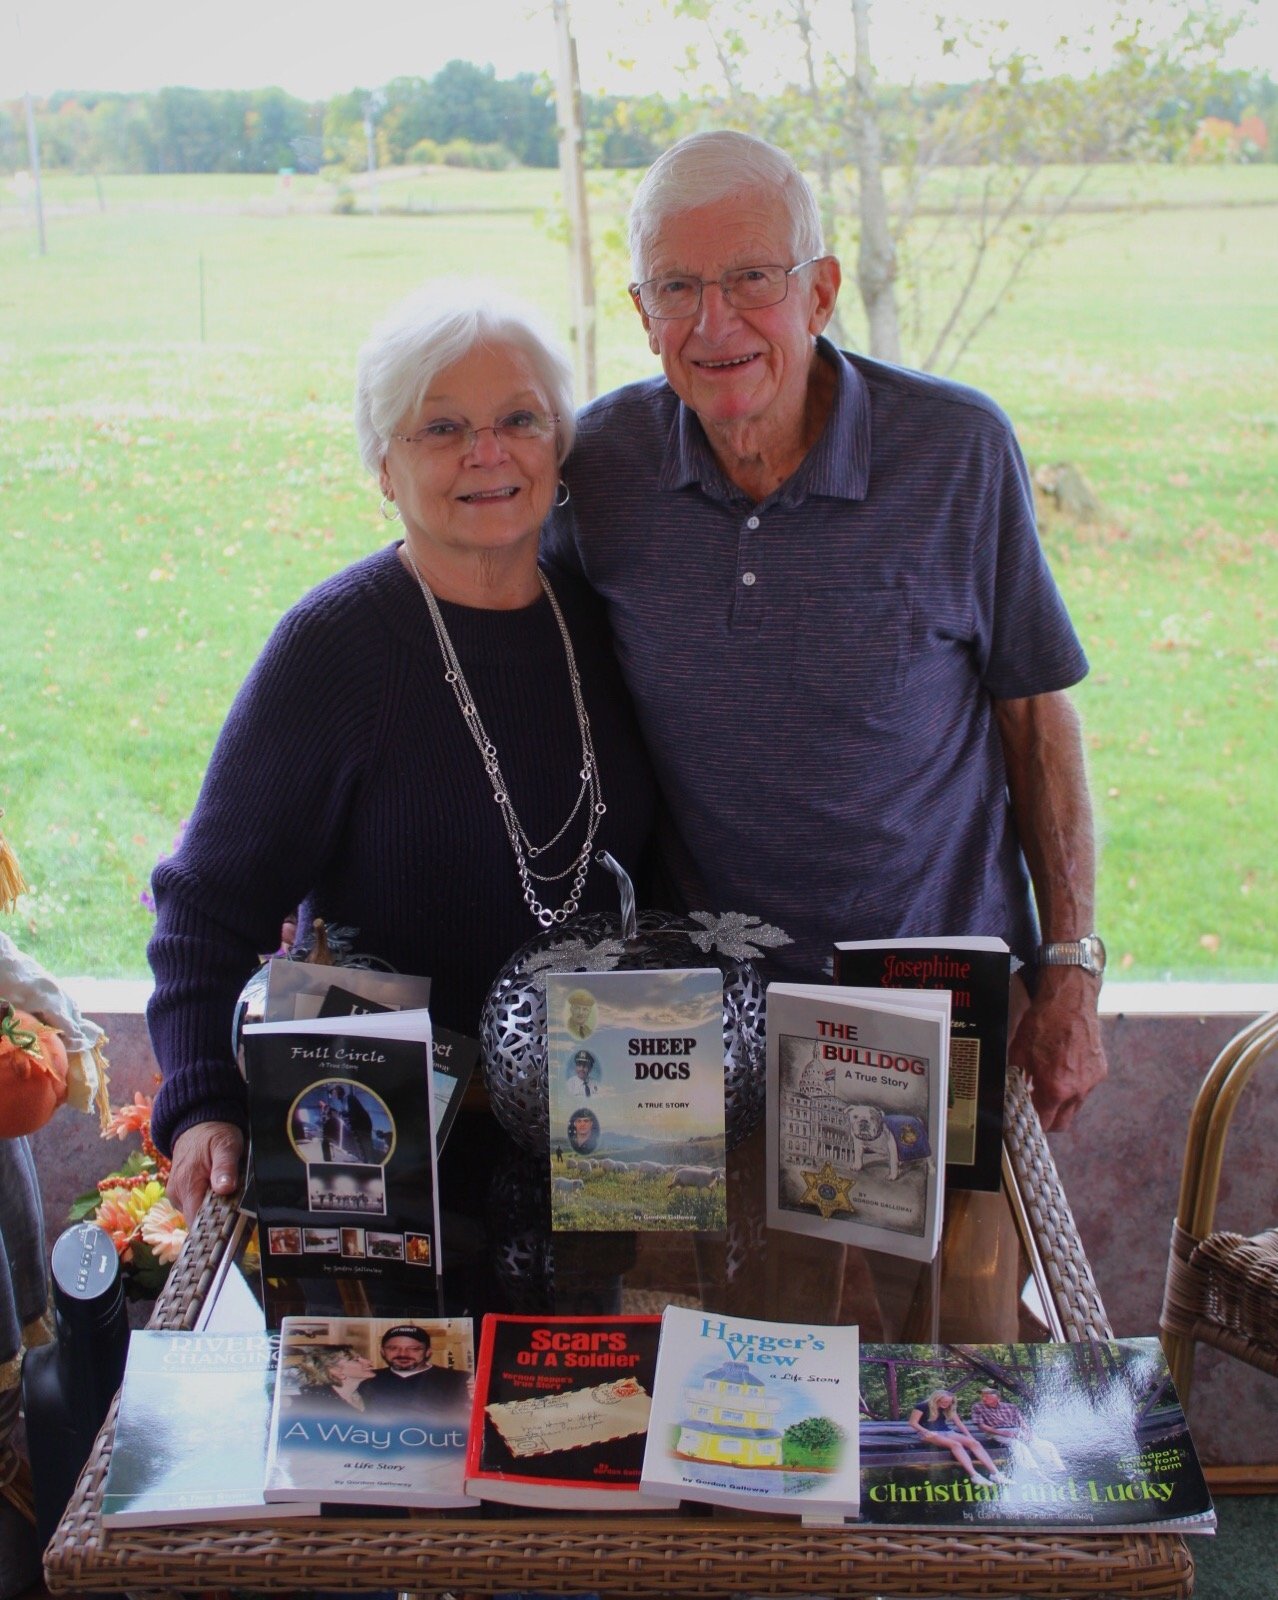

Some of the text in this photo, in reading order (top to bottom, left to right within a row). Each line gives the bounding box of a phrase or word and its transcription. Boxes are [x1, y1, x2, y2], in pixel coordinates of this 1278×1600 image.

[881, 954, 971, 983] Josephine
[816, 1020, 858, 1041] THE
[290, 1046, 387, 1063] Full Circle
[628, 1038, 697, 1056] SHEEP
[822, 1044, 925, 1077] BULLDOG
[634, 1062, 691, 1080] DOGS
[845, 1071, 909, 1090] A True Story
[530, 1328, 627, 1351] Scars
[699, 1318, 825, 1352] Harger's
[516, 1351, 640, 1368] Of A Soldier
[726, 1342, 799, 1367] View
[781, 1372, 802, 1382] Life
[807, 1373, 840, 1385] Story
[284, 1422, 466, 1449] A Way Out
[354, 1462, 374, 1470] Life
[376, 1462, 406, 1471] Story
[1154, 1454, 1180, 1465] from
[1154, 1462, 1182, 1472] Farm
[695, 1478, 727, 1488] Gordon
[729, 1483, 769, 1494] Galloway
[1087, 1480, 1175, 1503] Lucky
[963, 1511, 974, 1521] by
